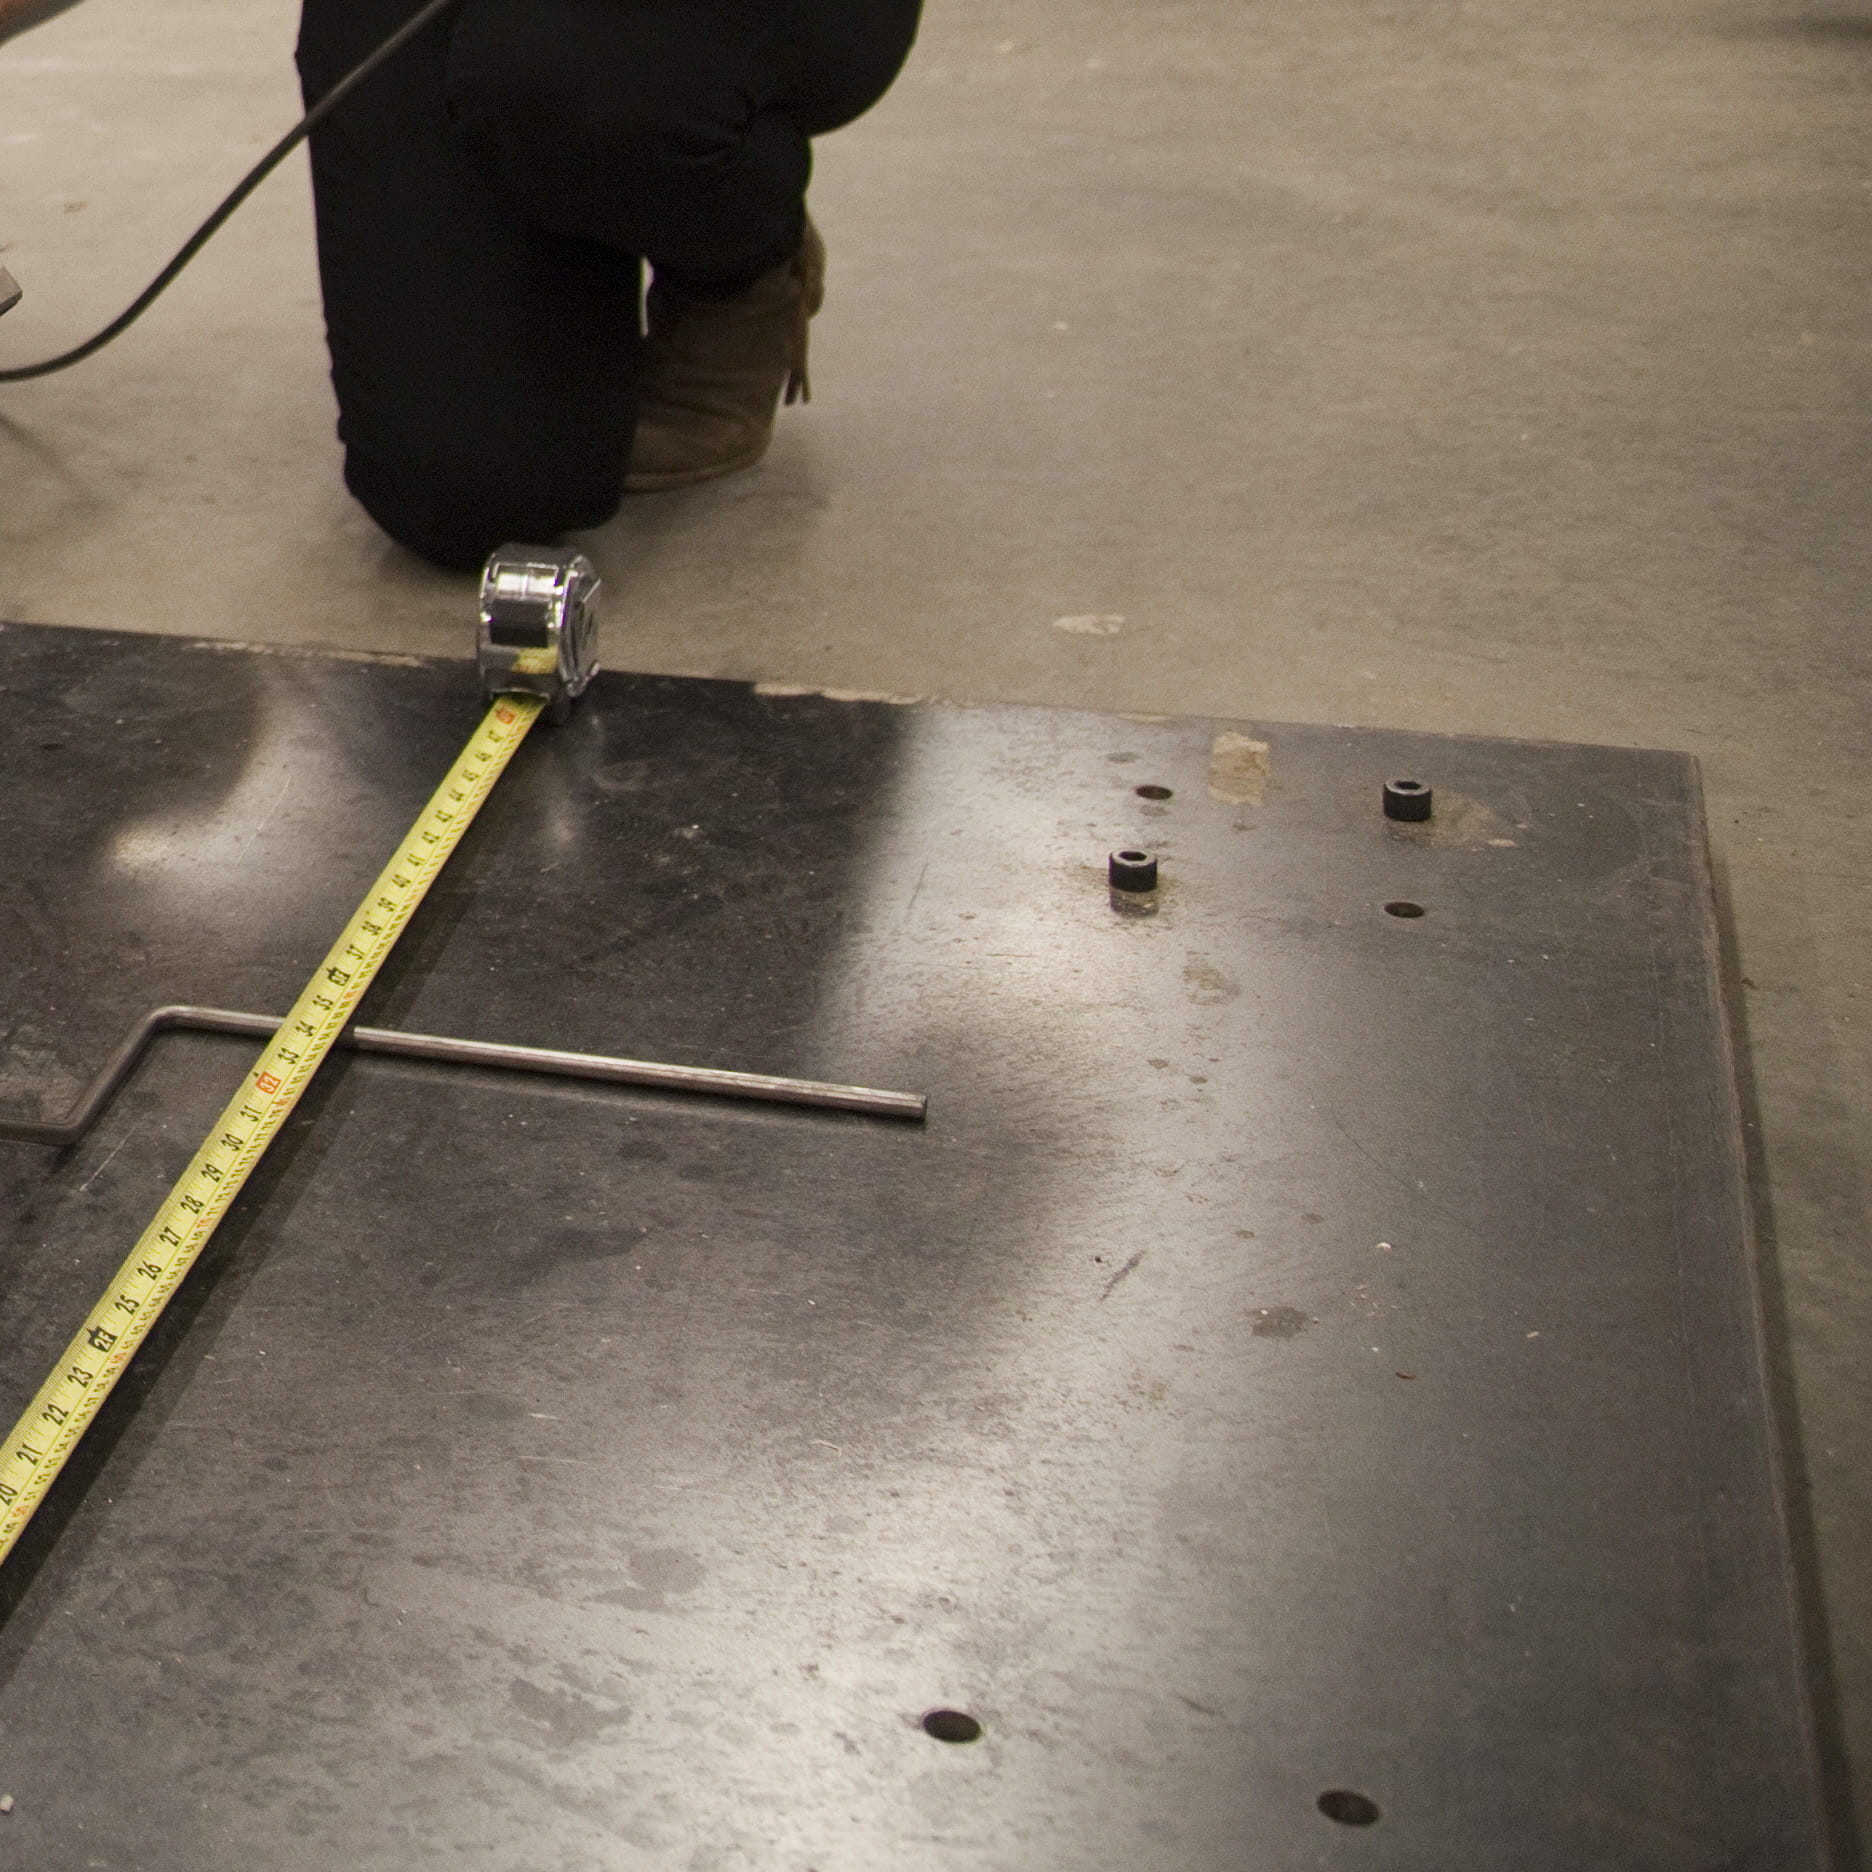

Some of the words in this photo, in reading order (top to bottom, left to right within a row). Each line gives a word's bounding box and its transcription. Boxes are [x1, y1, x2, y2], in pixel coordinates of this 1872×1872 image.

[16, 1442, 43, 1466] 21
[41, 1403, 69, 1426] 22
[67, 1366, 94, 1388] 23
[93, 1329, 117, 1351] 2F
[115, 1294, 140, 1315] 25
[137, 1260, 162, 1281] 26
[159, 1226, 182, 1247] 27
[180, 1194, 204, 1215] 28
[201, 1163, 224, 1183] 29
[220, 1133, 244, 1152] 30
[240, 1105, 263, 1122] 31
[259, 1074, 278, 1092] 32
[277, 1047, 300, 1064] 33
[295, 1020, 316, 1036] 34
[312, 994, 334, 1011] 35
